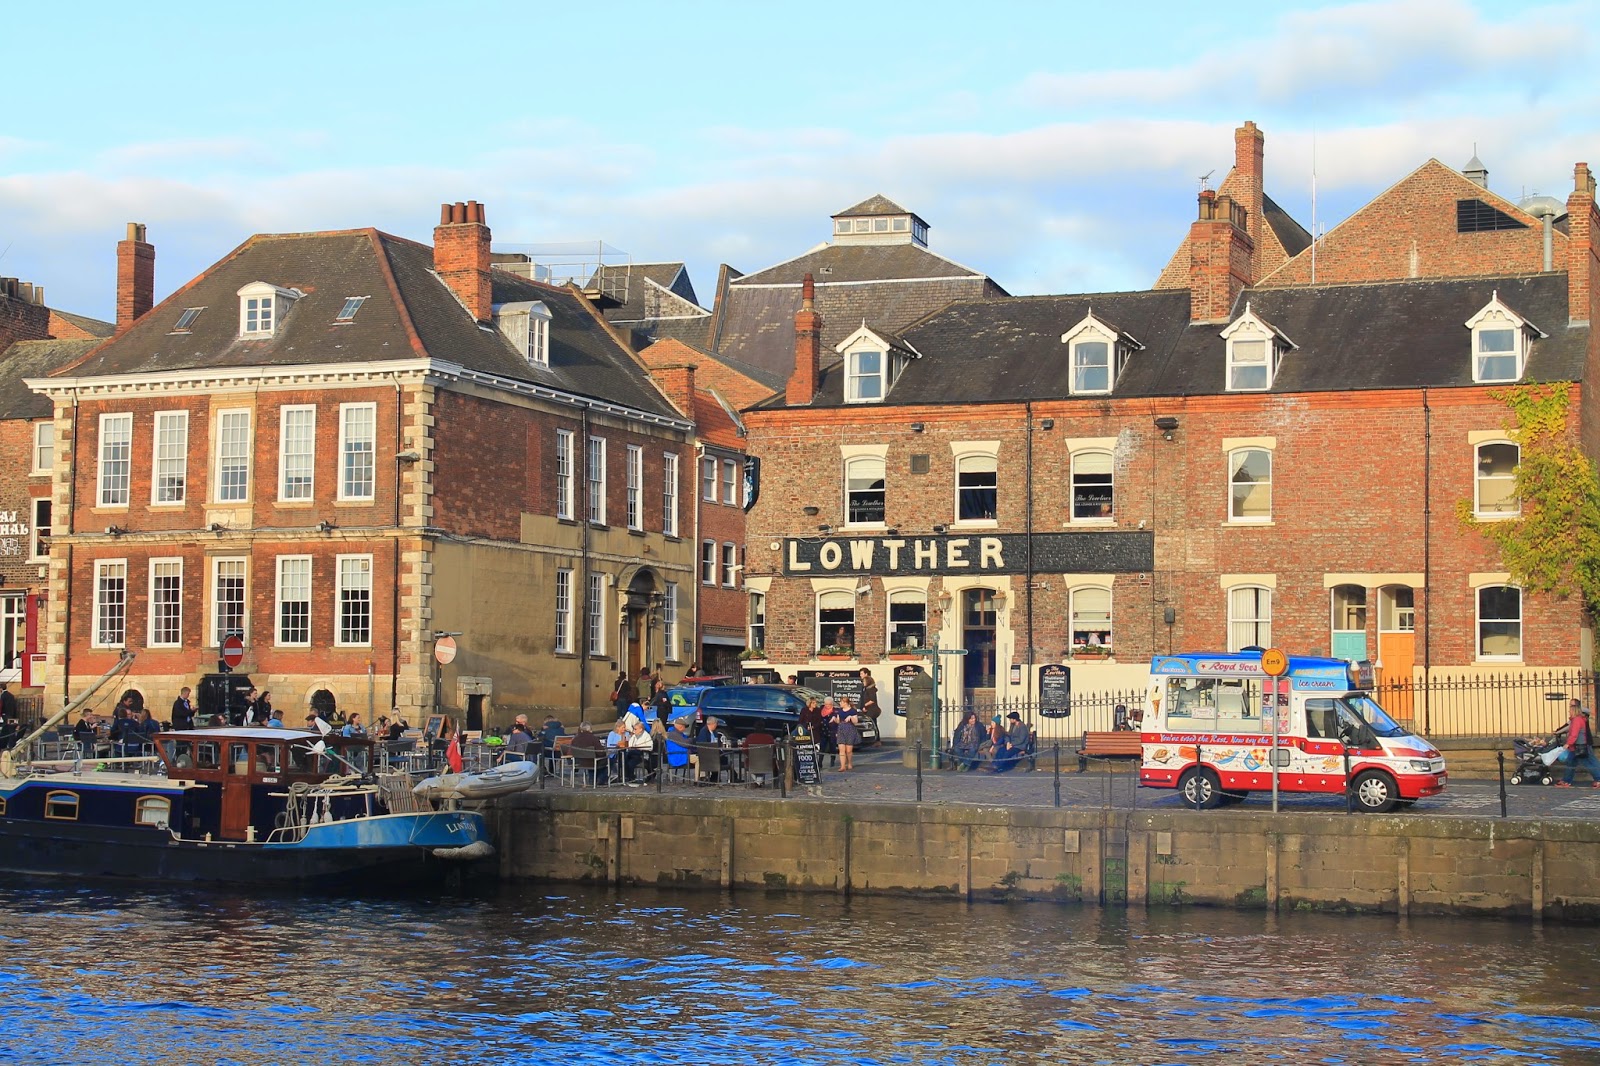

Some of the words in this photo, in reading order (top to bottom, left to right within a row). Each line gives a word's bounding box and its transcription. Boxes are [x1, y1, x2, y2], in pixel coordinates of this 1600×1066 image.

[789, 537, 1004, 571] LOWTHER
[1209, 661, 1237, 672] Royd
[1238, 662, 1258, 671] Ices
[1160, 733, 1179, 742] You've
[446, 822, 477, 833] LINTON
